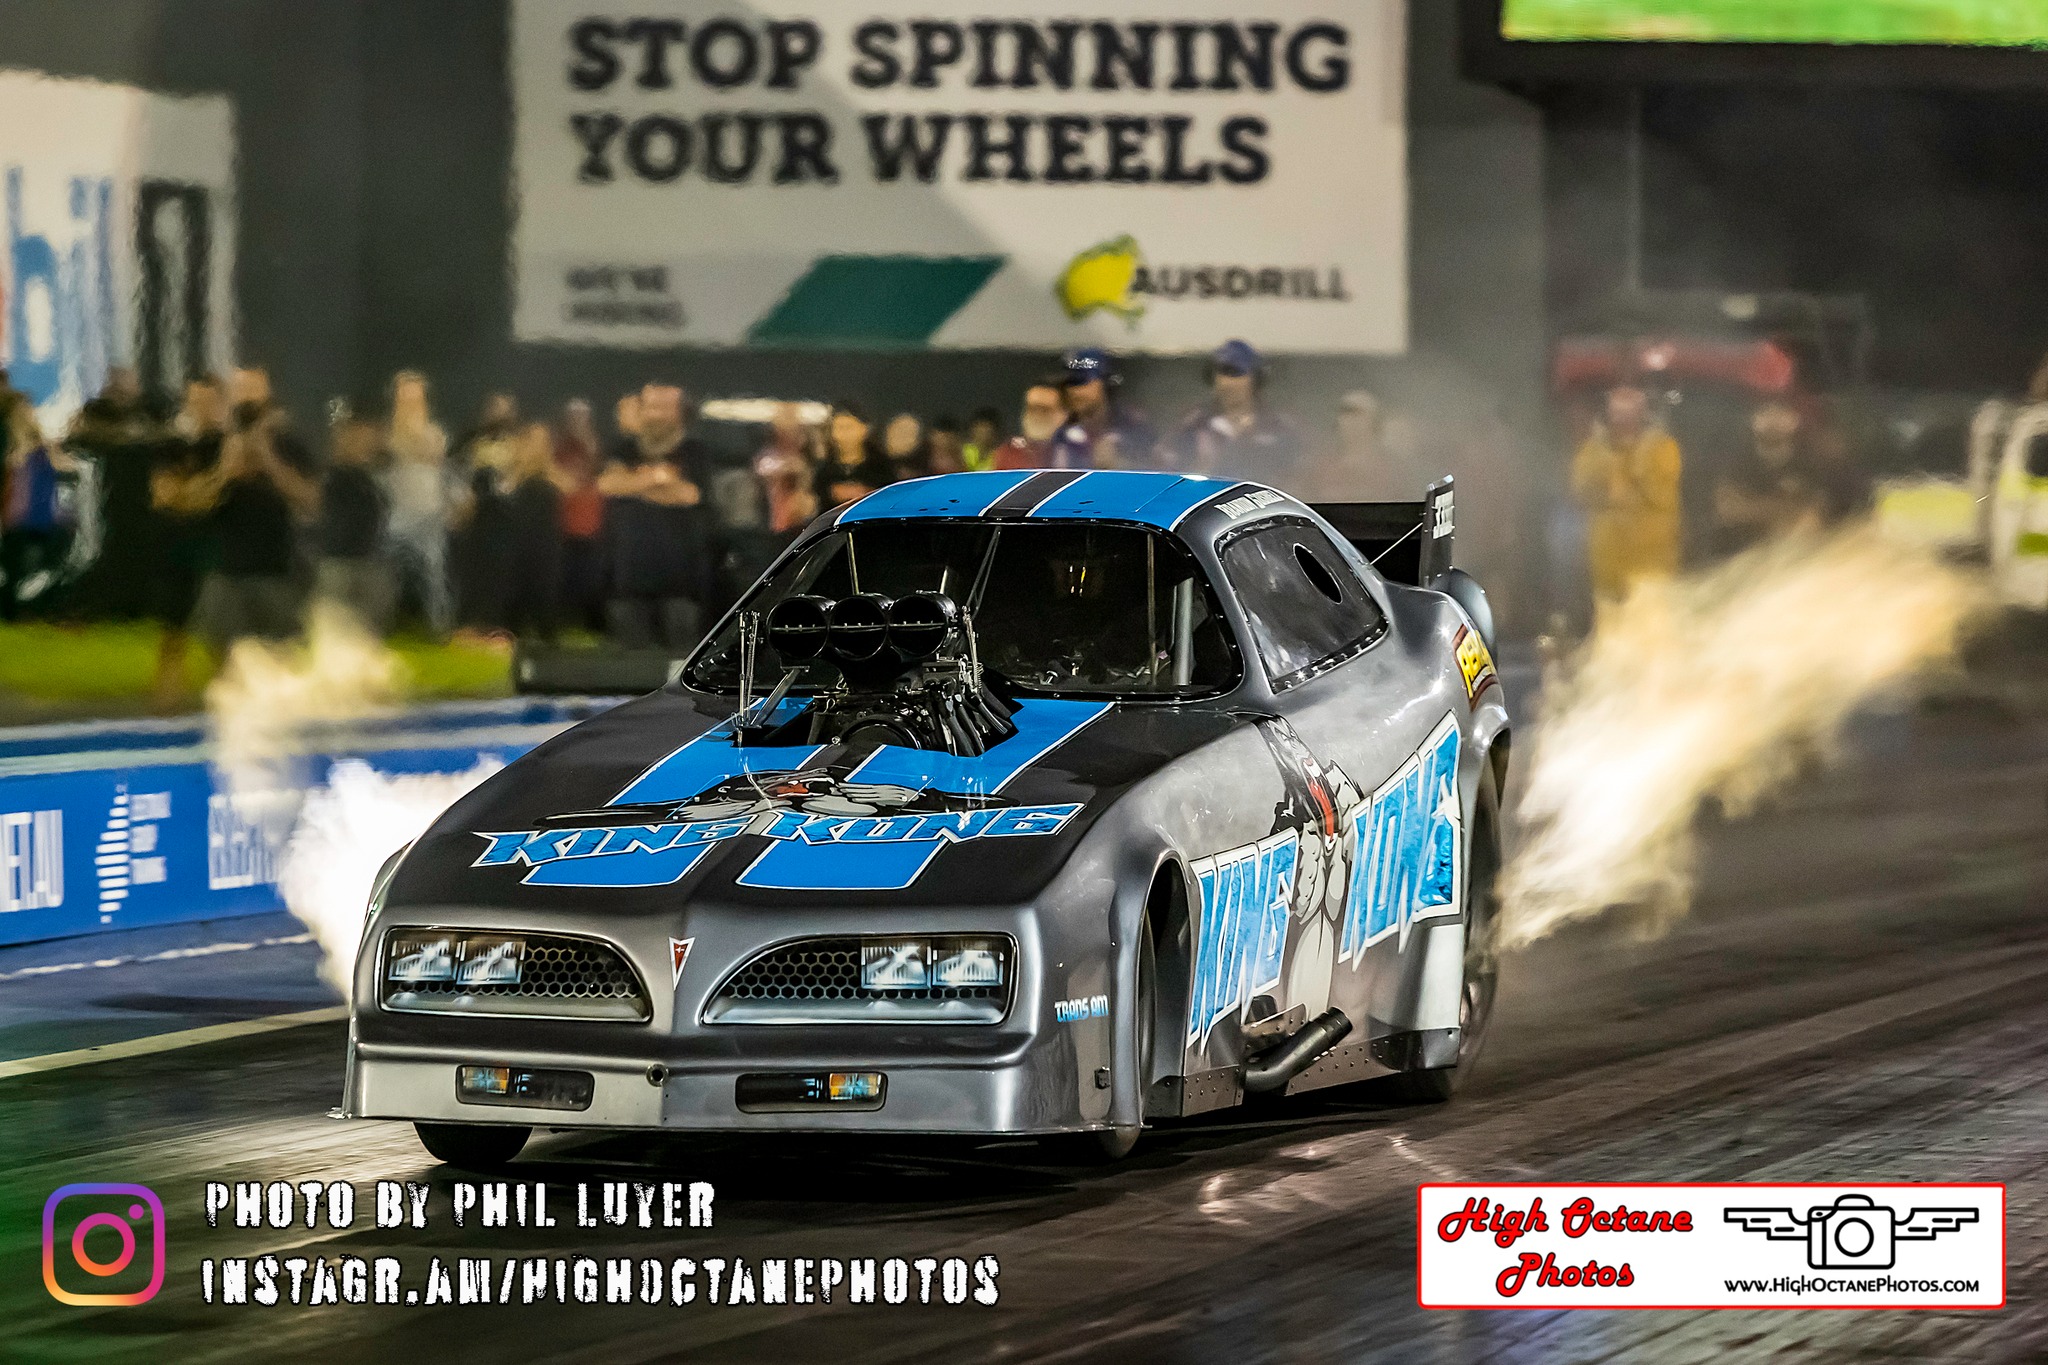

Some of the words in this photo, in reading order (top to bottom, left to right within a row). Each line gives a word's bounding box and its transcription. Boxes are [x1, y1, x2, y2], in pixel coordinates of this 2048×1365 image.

[568, 17, 822, 91] STOP
[850, 18, 1351, 92] SPINNING
[568, 112, 841, 185] YOUR
[862, 112, 1271, 185] WHEELS
[1131, 263, 1352, 302] AUSDRILL
[470, 814, 759, 868] KING
[759, 802, 1086, 845] KONG
